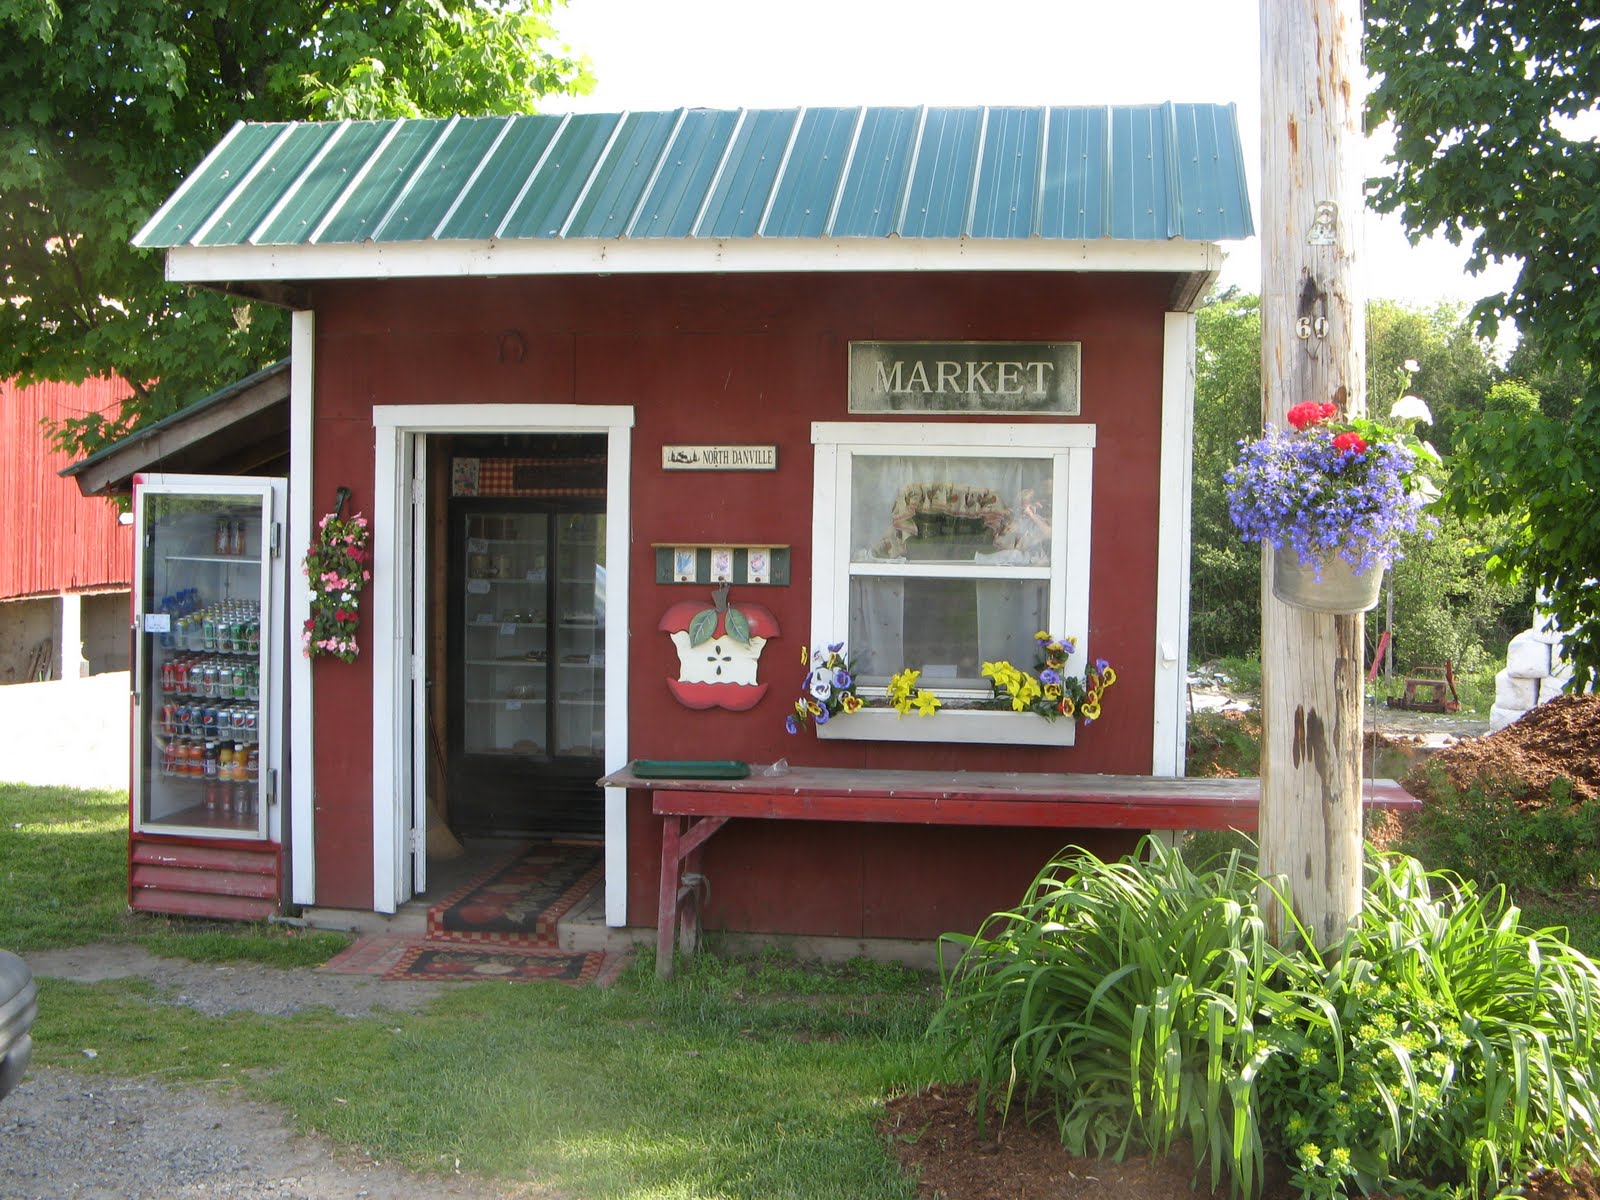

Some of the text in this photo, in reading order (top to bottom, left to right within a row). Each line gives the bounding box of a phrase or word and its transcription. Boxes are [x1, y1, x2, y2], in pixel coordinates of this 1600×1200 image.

[876, 360, 1054, 394] MARKET
[702, 450, 773, 464] NORTH DANVILLE
